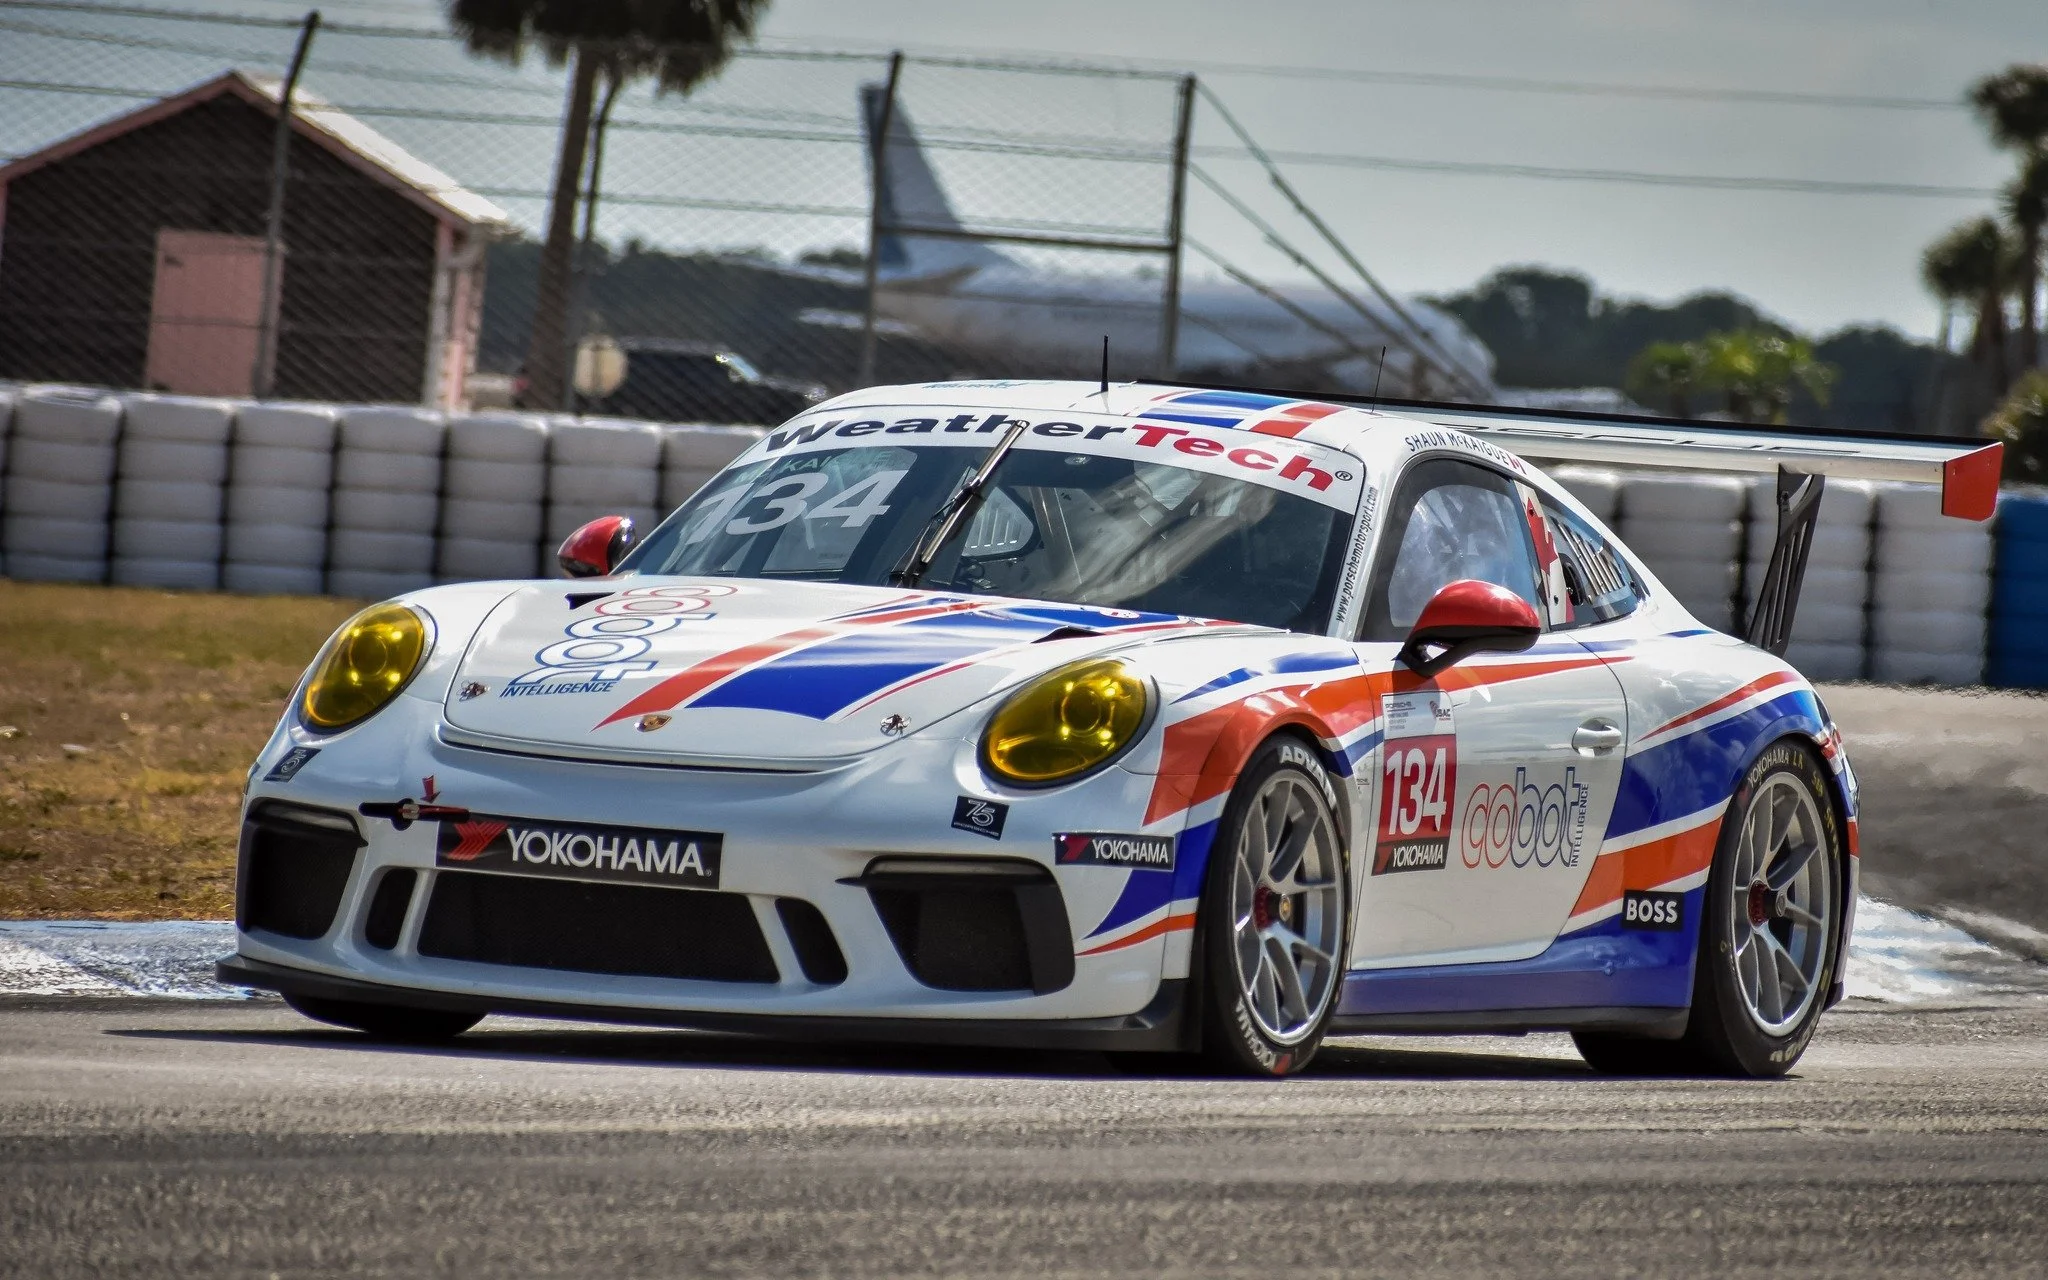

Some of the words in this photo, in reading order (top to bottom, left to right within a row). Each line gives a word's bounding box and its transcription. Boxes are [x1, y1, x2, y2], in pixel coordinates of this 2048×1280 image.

[1405, 431, 1446, 452] SHAUN
[1446, 432, 1509, 465] McKAIGUE
[686, 469, 909, 545] 134
[1336, 486, 1378, 623] www.porschemotorsport.com
[500, 681, 616, 697] INTELLIGENCE
[1280, 745, 1337, 810] ADVAN
[1385, 747, 1447, 835] 134
[1570, 783, 1590, 868] INTELLIGENCE
[507, 828, 705, 877] YOKOHAMA
[1092, 838, 1169, 864] YOKOHAMA
[1392, 843, 1445, 869] YOKOHAMA
[1625, 898, 1679, 925] BOSS
